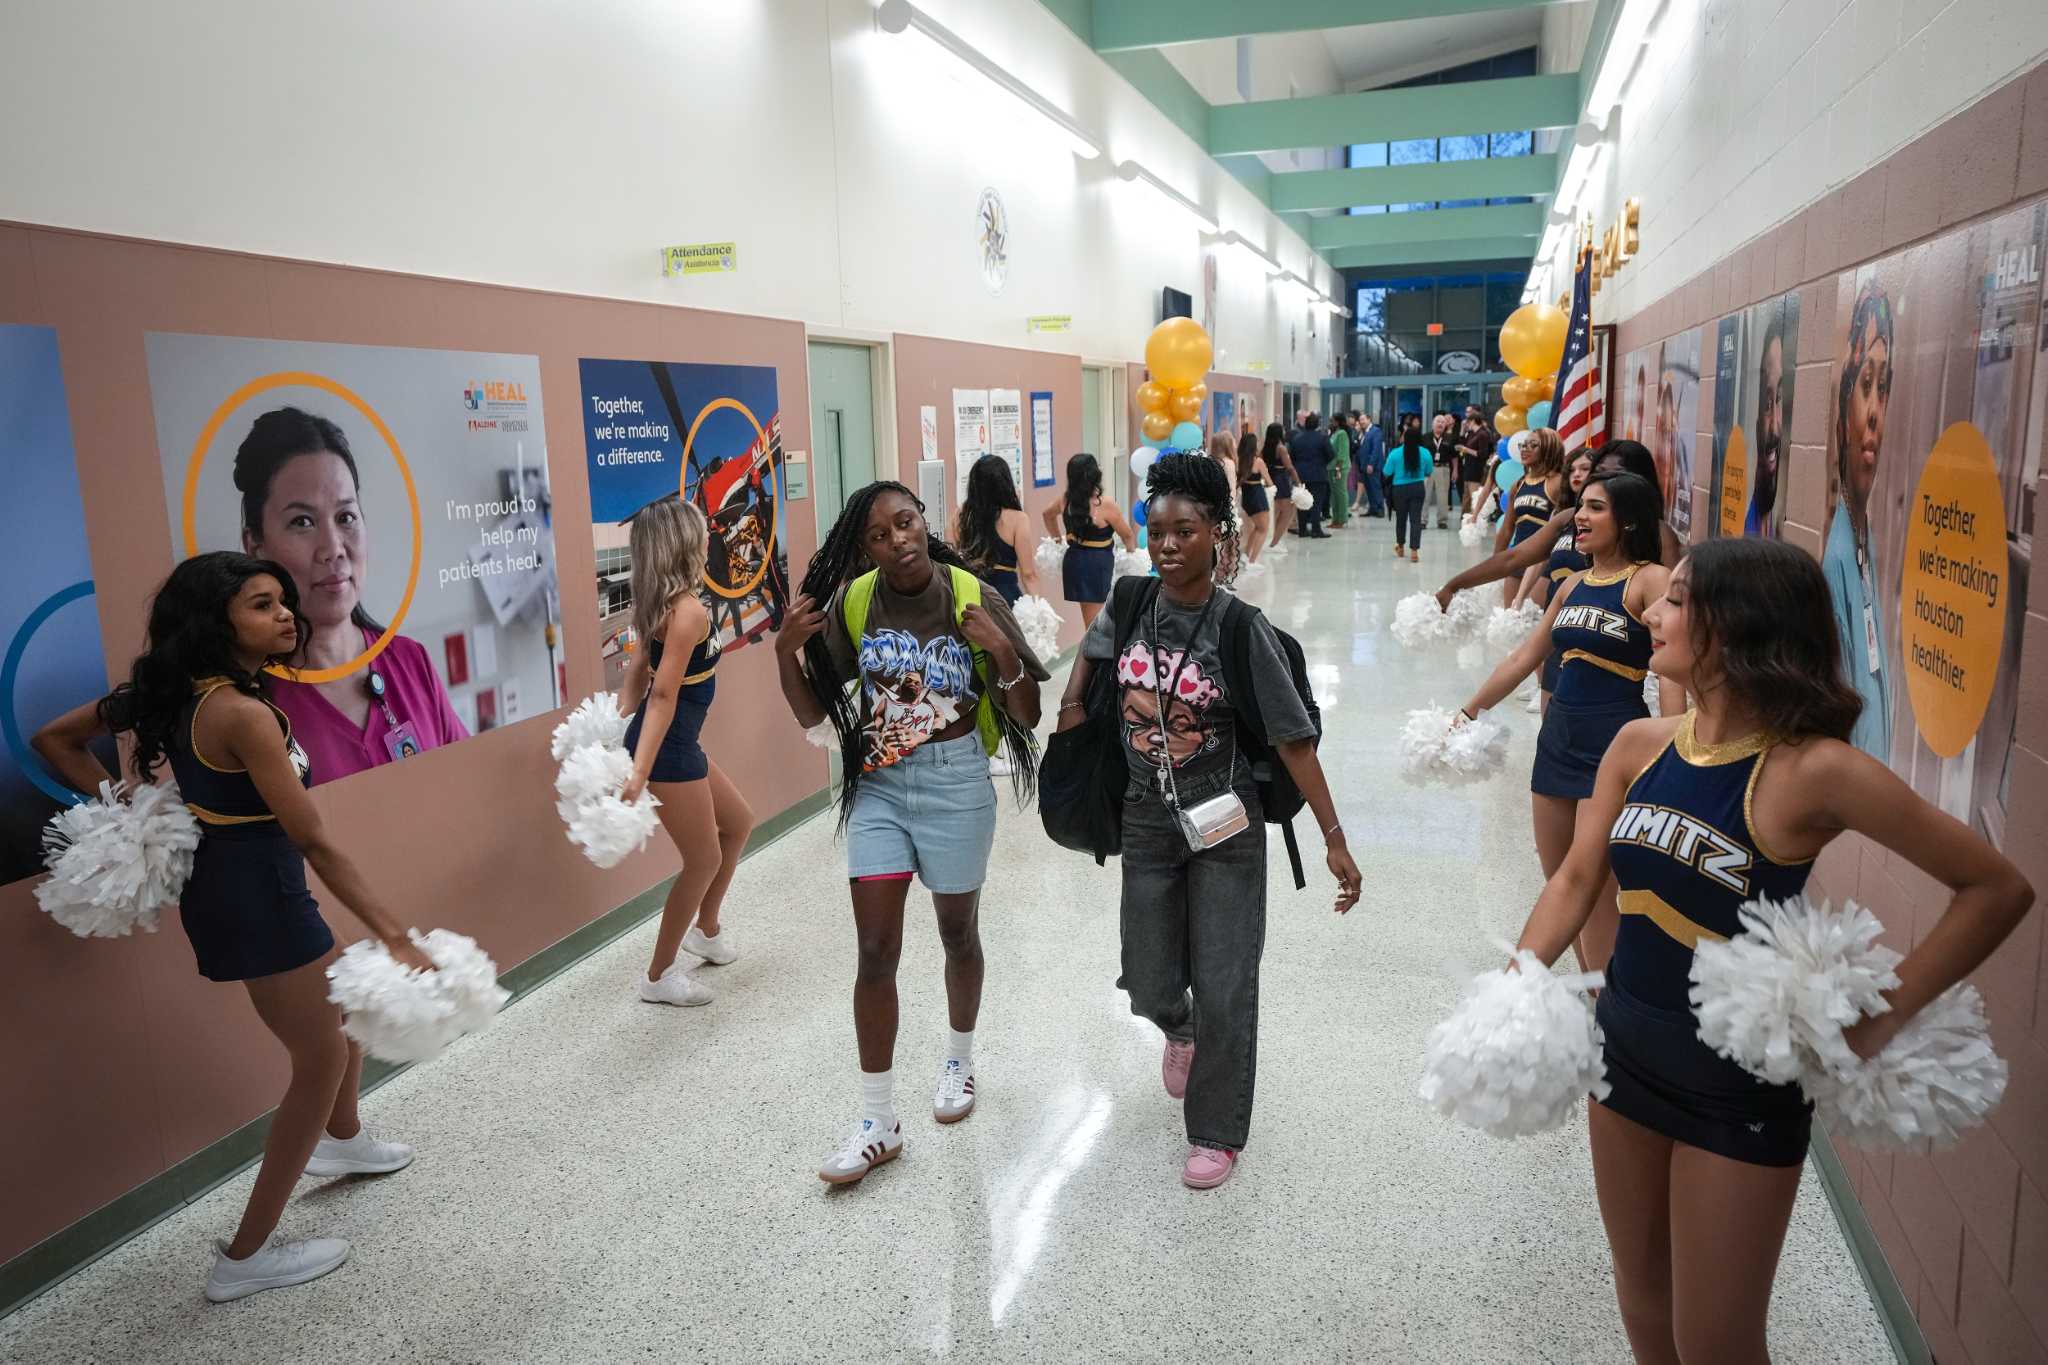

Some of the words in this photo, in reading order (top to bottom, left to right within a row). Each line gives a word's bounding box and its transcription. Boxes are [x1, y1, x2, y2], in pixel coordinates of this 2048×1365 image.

[671, 244, 732, 258] Attendance
[1996, 244, 2039, 290] HEAL
[484, 382, 527, 401] HEAL
[592, 396, 644, 418] Together,
[595, 422, 626, 440] we're
[628, 421, 669, 442] making
[597, 453, 606, 466] a
[608, 448, 665, 466] difference.
[446, 500, 471, 520] I'm
[475, 495, 519, 523] proud
[520, 495, 537, 513] to
[1923, 494, 1976, 543] Together,
[481, 526, 514, 550] help
[517, 527, 539, 546] my
[439, 558, 504, 590] patients
[506, 549, 542, 574] heal.
[1919, 546, 1948, 579] we're
[1949, 557, 1999, 608] making
[1914, 588, 1964, 639] Houston
[1911, 634, 1965, 692] healthier.
